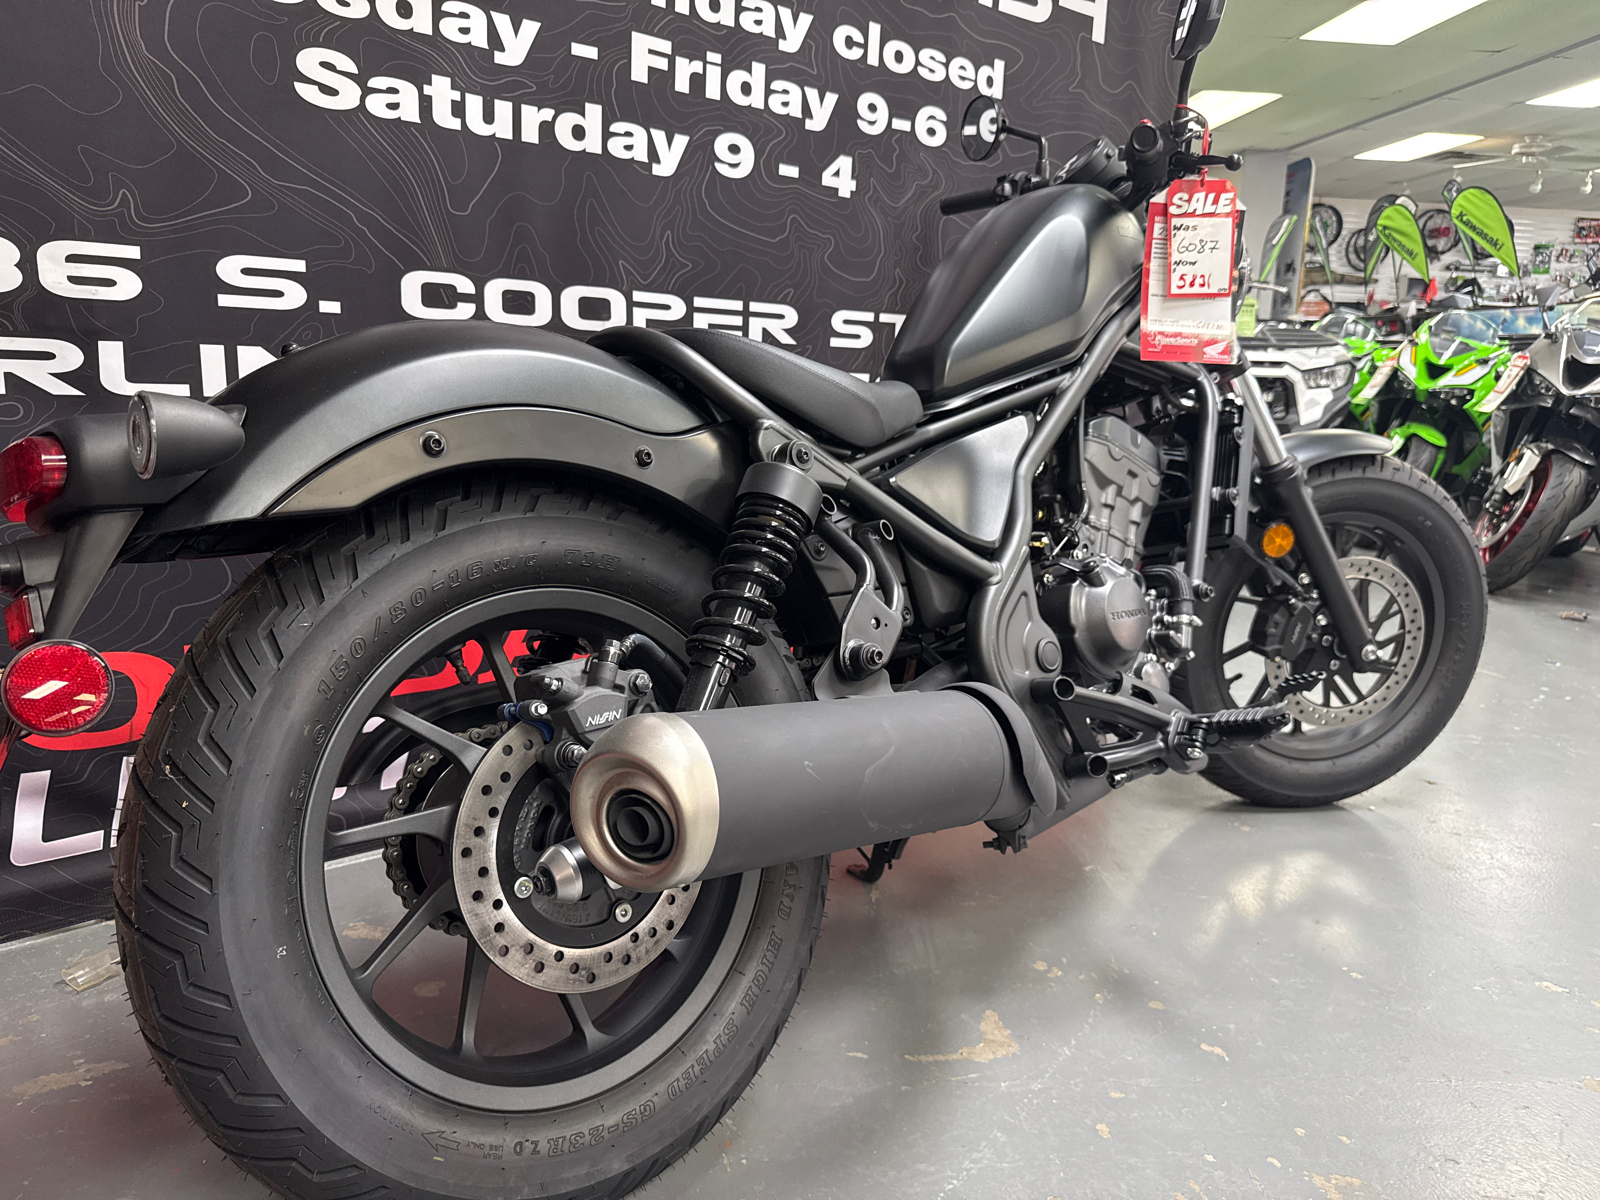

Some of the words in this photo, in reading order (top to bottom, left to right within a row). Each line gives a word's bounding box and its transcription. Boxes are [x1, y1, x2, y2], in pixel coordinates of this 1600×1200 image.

[630, 31, 839, 131] Friday
[857, 92, 947, 147] 9-6
[832, 21, 1005, 99] closed
[293, 47, 690, 177] Saturday
[713, 132, 755, 179] 9
[821, 154, 857, 198] 4
[1168, 191, 1235, 215] SALE
[1455, 210, 1505, 252] Kawasaki
[1176, 237, 1219, 254] 6087
[0, 236, 143, 301] 6
[400, 270, 798, 346] COOPER
[1109, 607, 1148, 622] HONDA
[740, 930, 784, 1016] HIGH
[666, 1017, 740, 1101] SPEED
